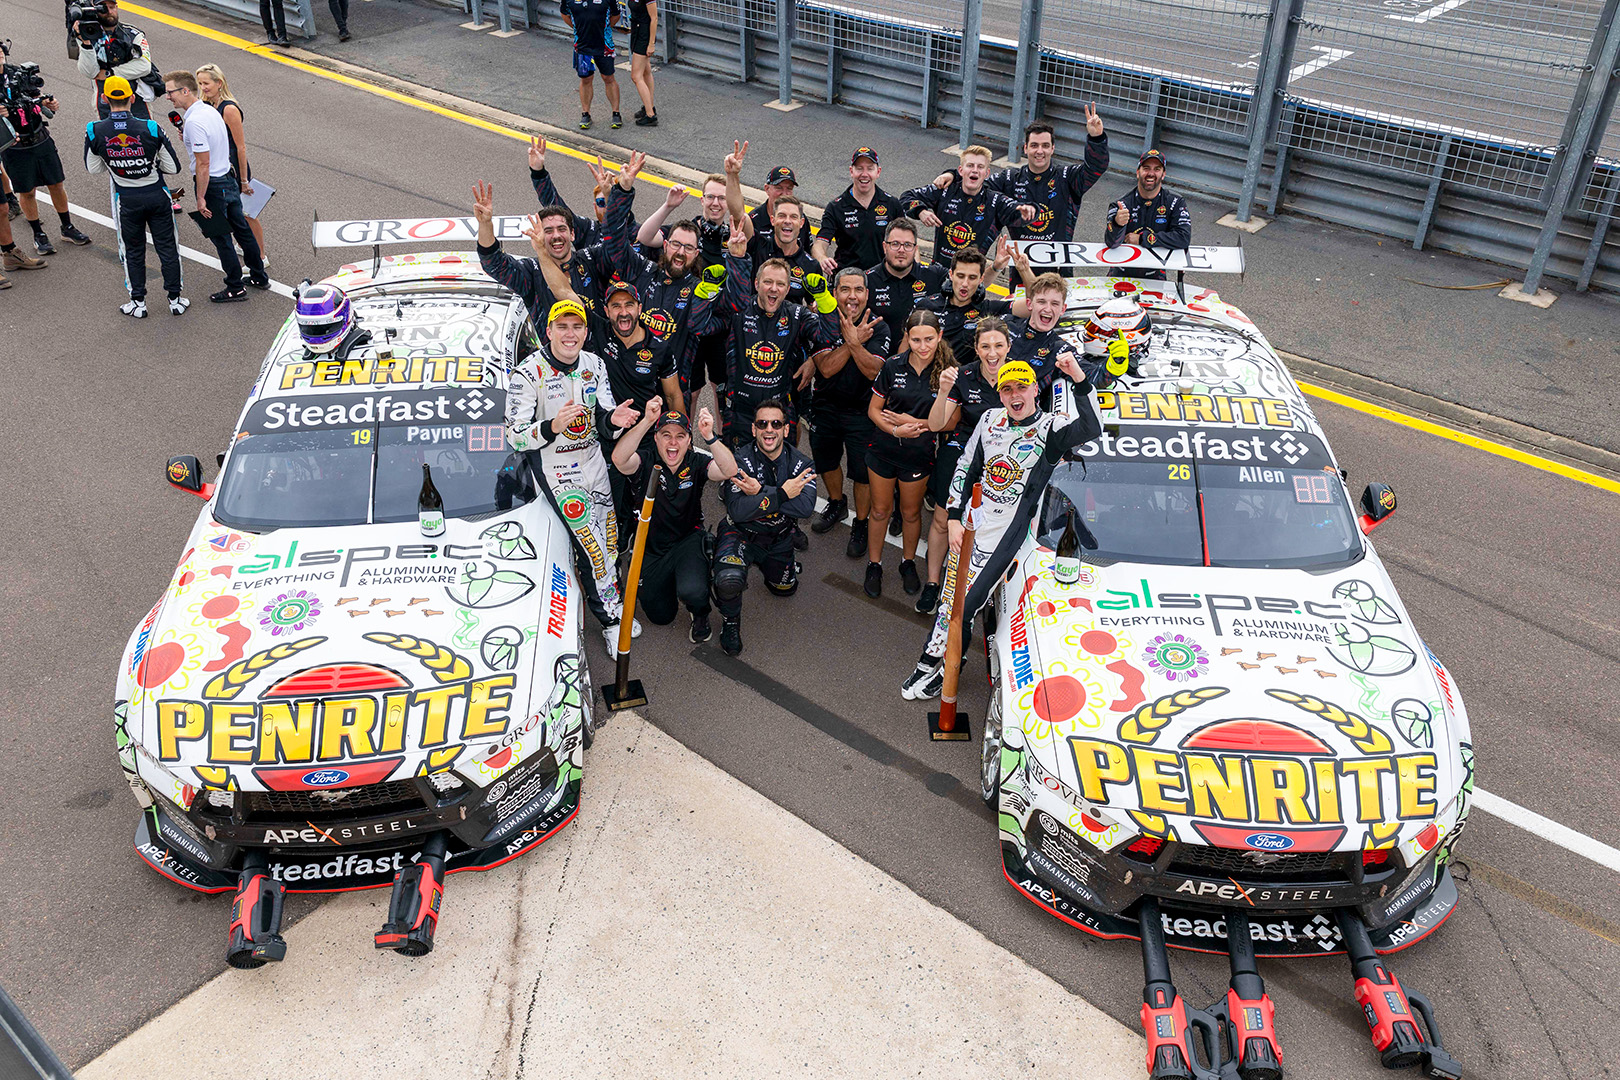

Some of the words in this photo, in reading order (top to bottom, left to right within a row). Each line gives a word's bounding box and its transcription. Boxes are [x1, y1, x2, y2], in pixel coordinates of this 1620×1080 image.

[109, 157, 151, 168] AMPOL
[336, 217, 523, 243] GROVE
[943, 225, 977, 241] PENRITE
[1023, 241, 1213, 269] GROVE
[639, 311, 678, 333] PENRITE
[744, 348, 785, 361] PENRITE
[280, 356, 485, 389] PENRITE
[744, 374, 773, 384] RACING
[548, 383, 564, 391] APEX
[263, 396, 451, 429] Steadfast
[1097, 390, 1293, 428] PENRITE
[350, 428, 371, 445] 19
[407, 426, 464, 443] Payne
[1167, 464, 1191, 481] 26
[1239, 466, 1285, 484] Allen
[421, 517, 443, 530] Kayo
[236, 542, 247, 551] E
[575, 525, 608, 580] PENRITE
[237, 540, 484, 588] alspec
[361, 565, 458, 578] ALUMINIUM
[941, 551, 959, 604] PENRITE
[1057, 562, 1079, 577] Kayo
[232, 571, 336, 590] EVERYTHING
[357, 578, 368, 586] &
[372, 575, 457, 586] HARDWARE
[546, 562, 567, 640] TRADEZONE
[1096, 579, 1348, 637] alspec
[1100, 615, 1206, 627] EVERYTHING
[1232, 618, 1329, 635] ALUMINIUM
[1010, 603, 1034, 690] TRADEZONE
[1233, 628, 1245, 637] &
[1247, 629, 1333, 645] HARDWARE
[156, 672, 517, 764] PENRITE
[501, 698, 555, 748] GROVE
[308, 769, 343, 785] Ford
[1028, 755, 1084, 810] GROVE
[1066, 736, 1439, 824] PENRITE
[495, 801, 540, 837] TASMANIAN
[539, 791, 554, 804] GIN
[263, 822, 341, 845] APEX
[341, 819, 417, 839] STEEL
[506, 826, 545, 856] APEX
[540, 803, 576, 829] STEEL
[1253, 834, 1287, 849] Ford
[162, 824, 199, 855] TASMANIAN
[196, 851, 210, 863] GIN
[136, 842, 174, 867] APEX
[168, 860, 200, 883] STEEL
[268, 852, 404, 882] teadfast
[1031, 850, 1078, 889] TASMANIAN
[1076, 886, 1093, 900] GIN
[1019, 879, 1061, 906] APEX
[1060, 902, 1101, 931] STEEL
[1176, 878, 1255, 905] APEX
[1260, 889, 1334, 901] STEEL
[1384, 886, 1421, 917] TASMANIAN
[1420, 877, 1433, 890] GIN
[1388, 918, 1425, 946] APEX
[1418, 900, 1451, 924] STEEL
